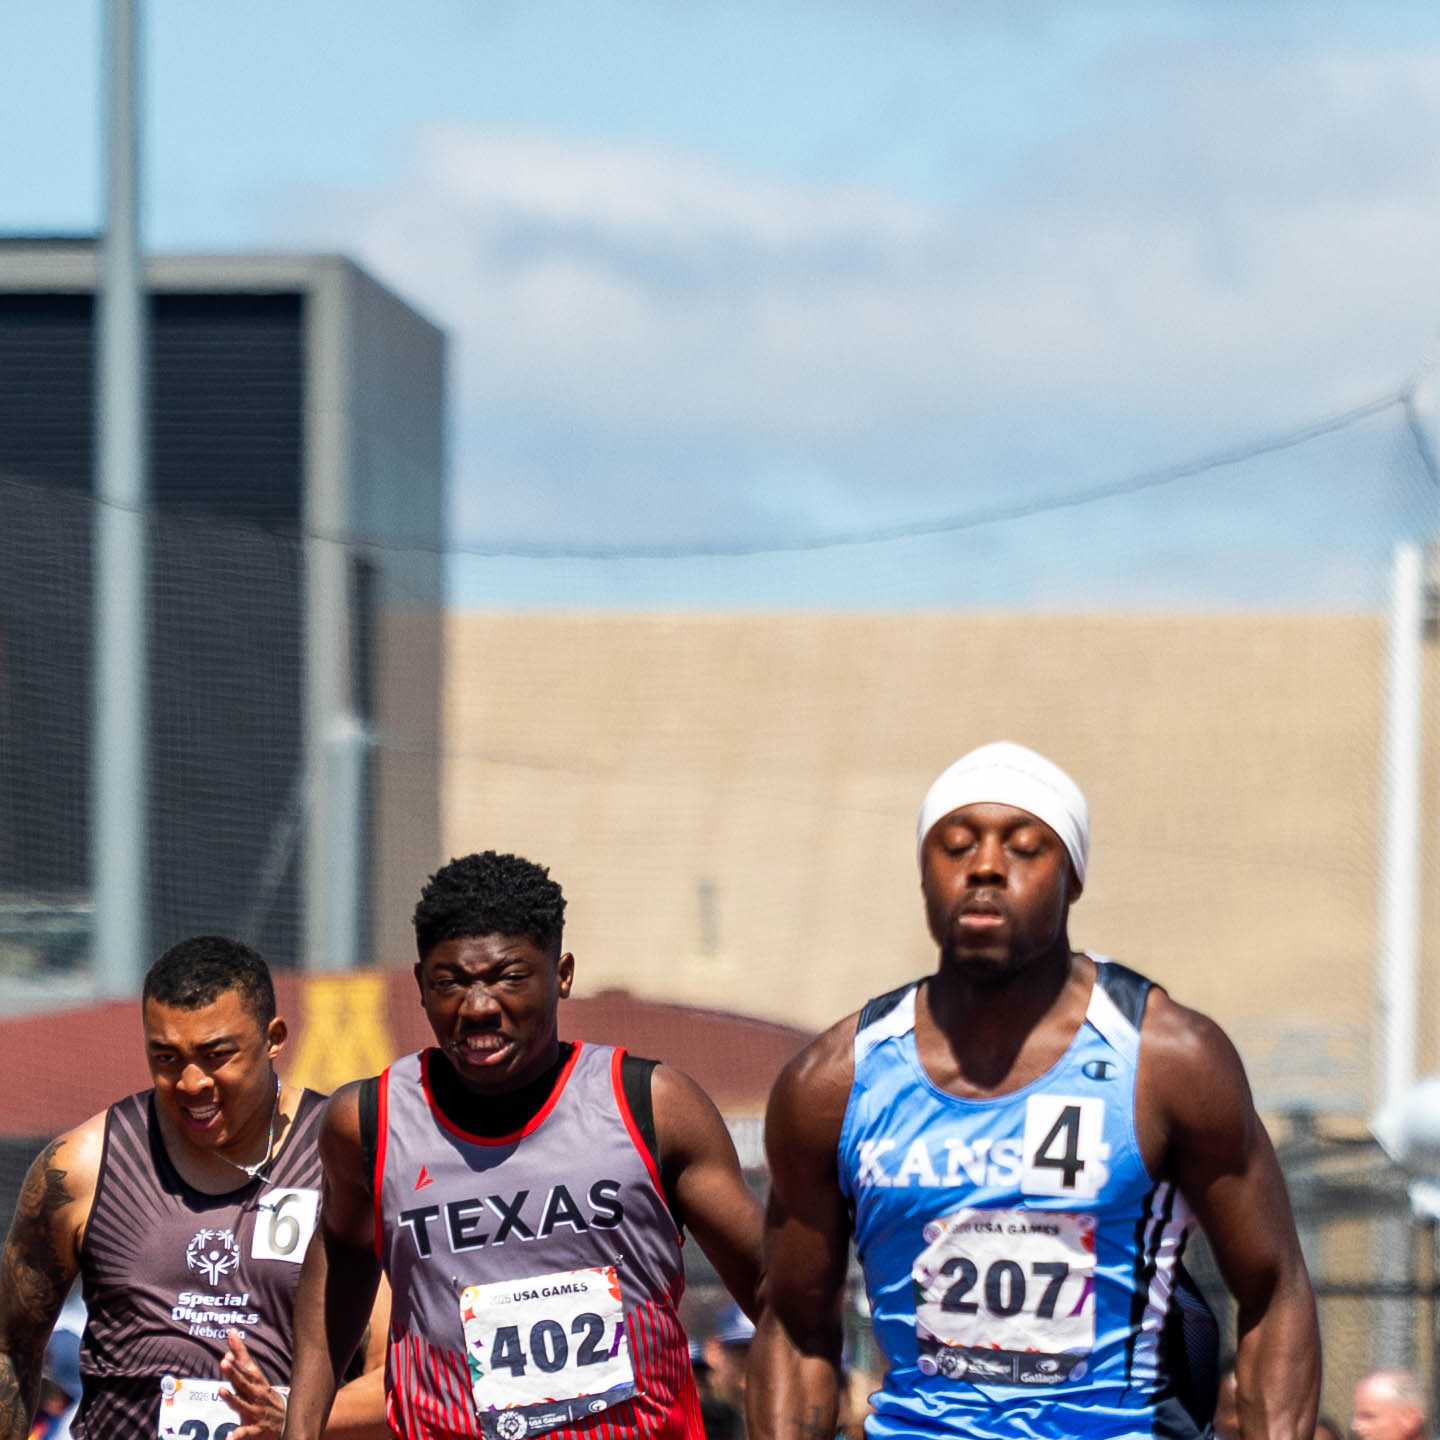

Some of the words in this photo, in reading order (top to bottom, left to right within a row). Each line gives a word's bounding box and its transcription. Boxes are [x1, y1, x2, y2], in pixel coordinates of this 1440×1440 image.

[857, 1138, 1109, 1190] KANS
[1034, 1105, 1085, 1189] 4
[268, 1194, 302, 1256] 6
[398, 1180, 625, 1259] TEXAS
[171, 1306, 260, 1325] Olympics
[178, 1292, 250, 1308] Special
[513, 1289, 540, 1302] USA
[541, 1282, 589, 1299] GAMES
[939, 1257, 1070, 1319] 207
[189, 1325, 245, 1340] Nebraa
[490, 1312, 609, 1377] 402
